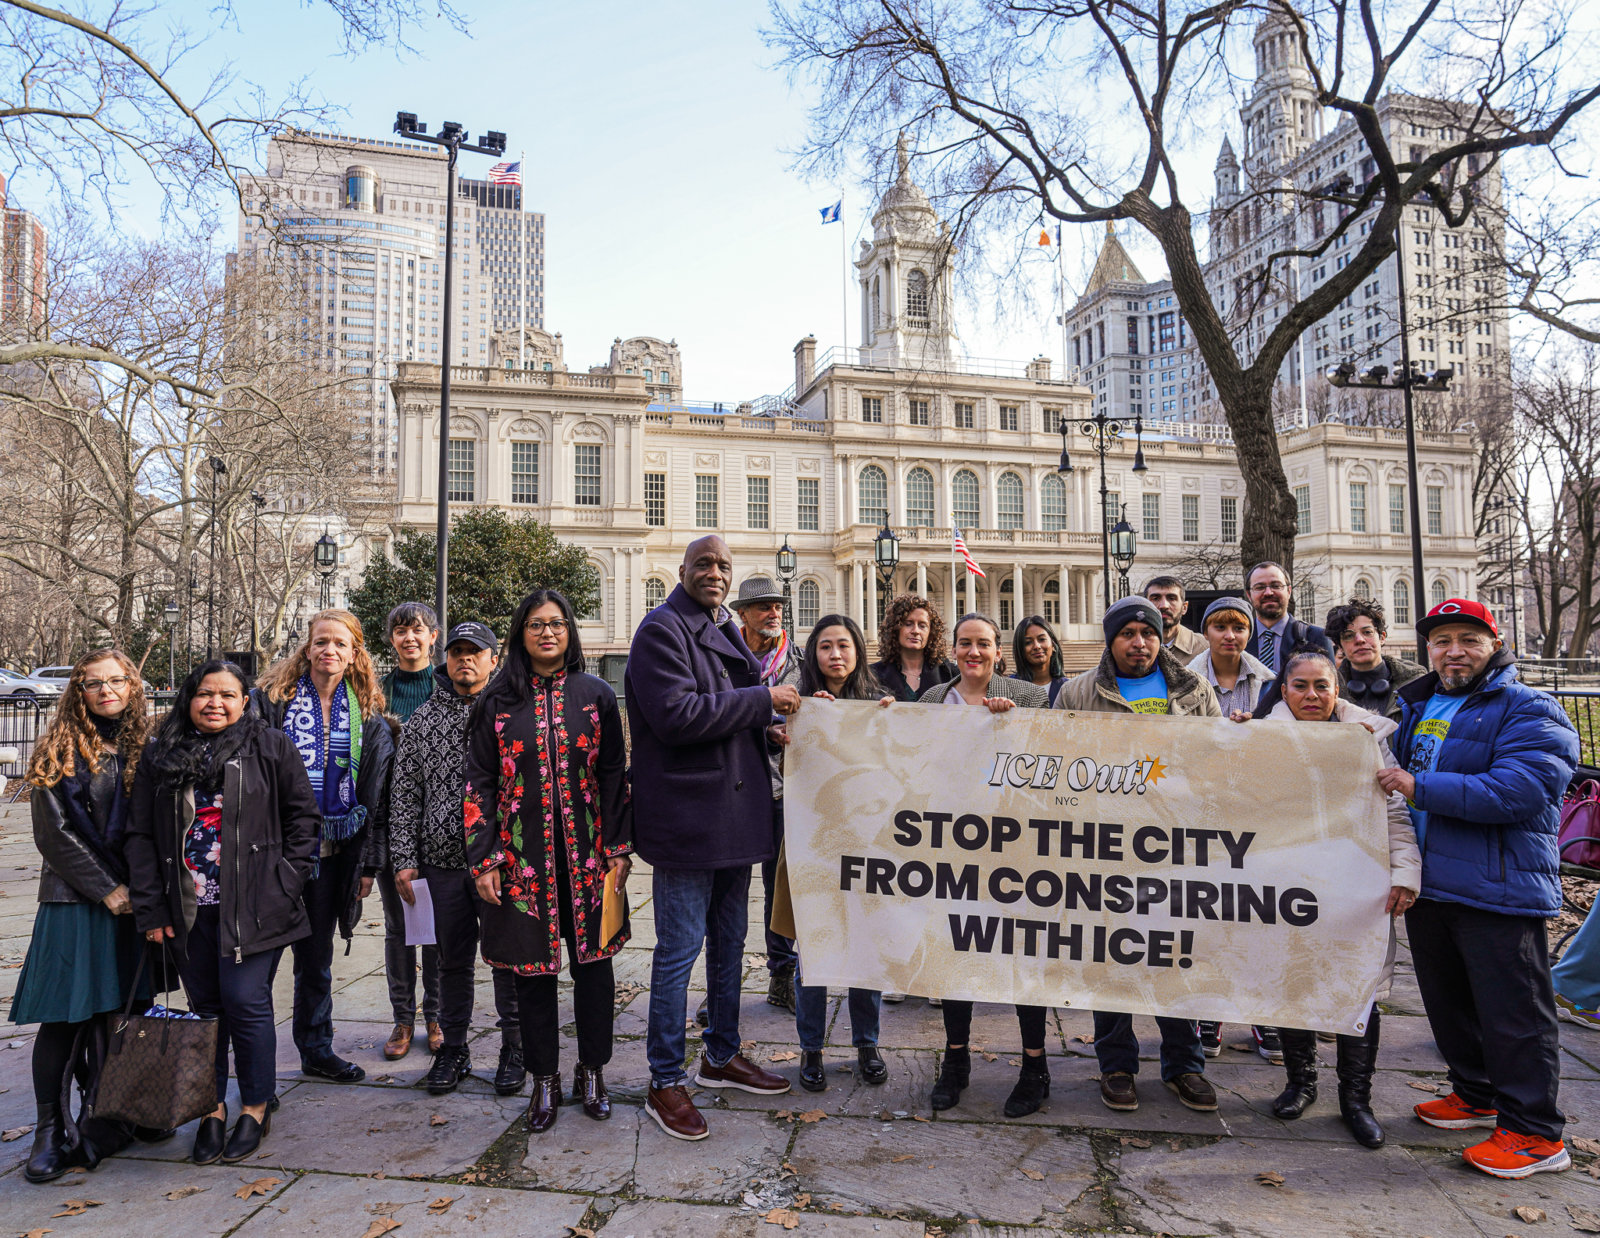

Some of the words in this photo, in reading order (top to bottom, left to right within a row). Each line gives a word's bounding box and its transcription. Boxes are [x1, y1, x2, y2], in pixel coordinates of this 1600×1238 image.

[294, 697, 316, 767] ROAD
[1135, 701, 1151, 710] THE
[988, 752, 1062, 790] ICE
[1067, 756, 1155, 795] Out!
[1055, 795, 1079, 807] NYC
[893, 809, 1022, 853] STOP
[1028, 818, 1124, 862] THE
[1132, 825, 1256, 870] CITY
[839, 854, 980, 902] FROM
[987, 866, 1319, 927] CONSPIRING
[948, 913, 1083, 962] WITH
[1092, 925, 1195, 970] ICE!
